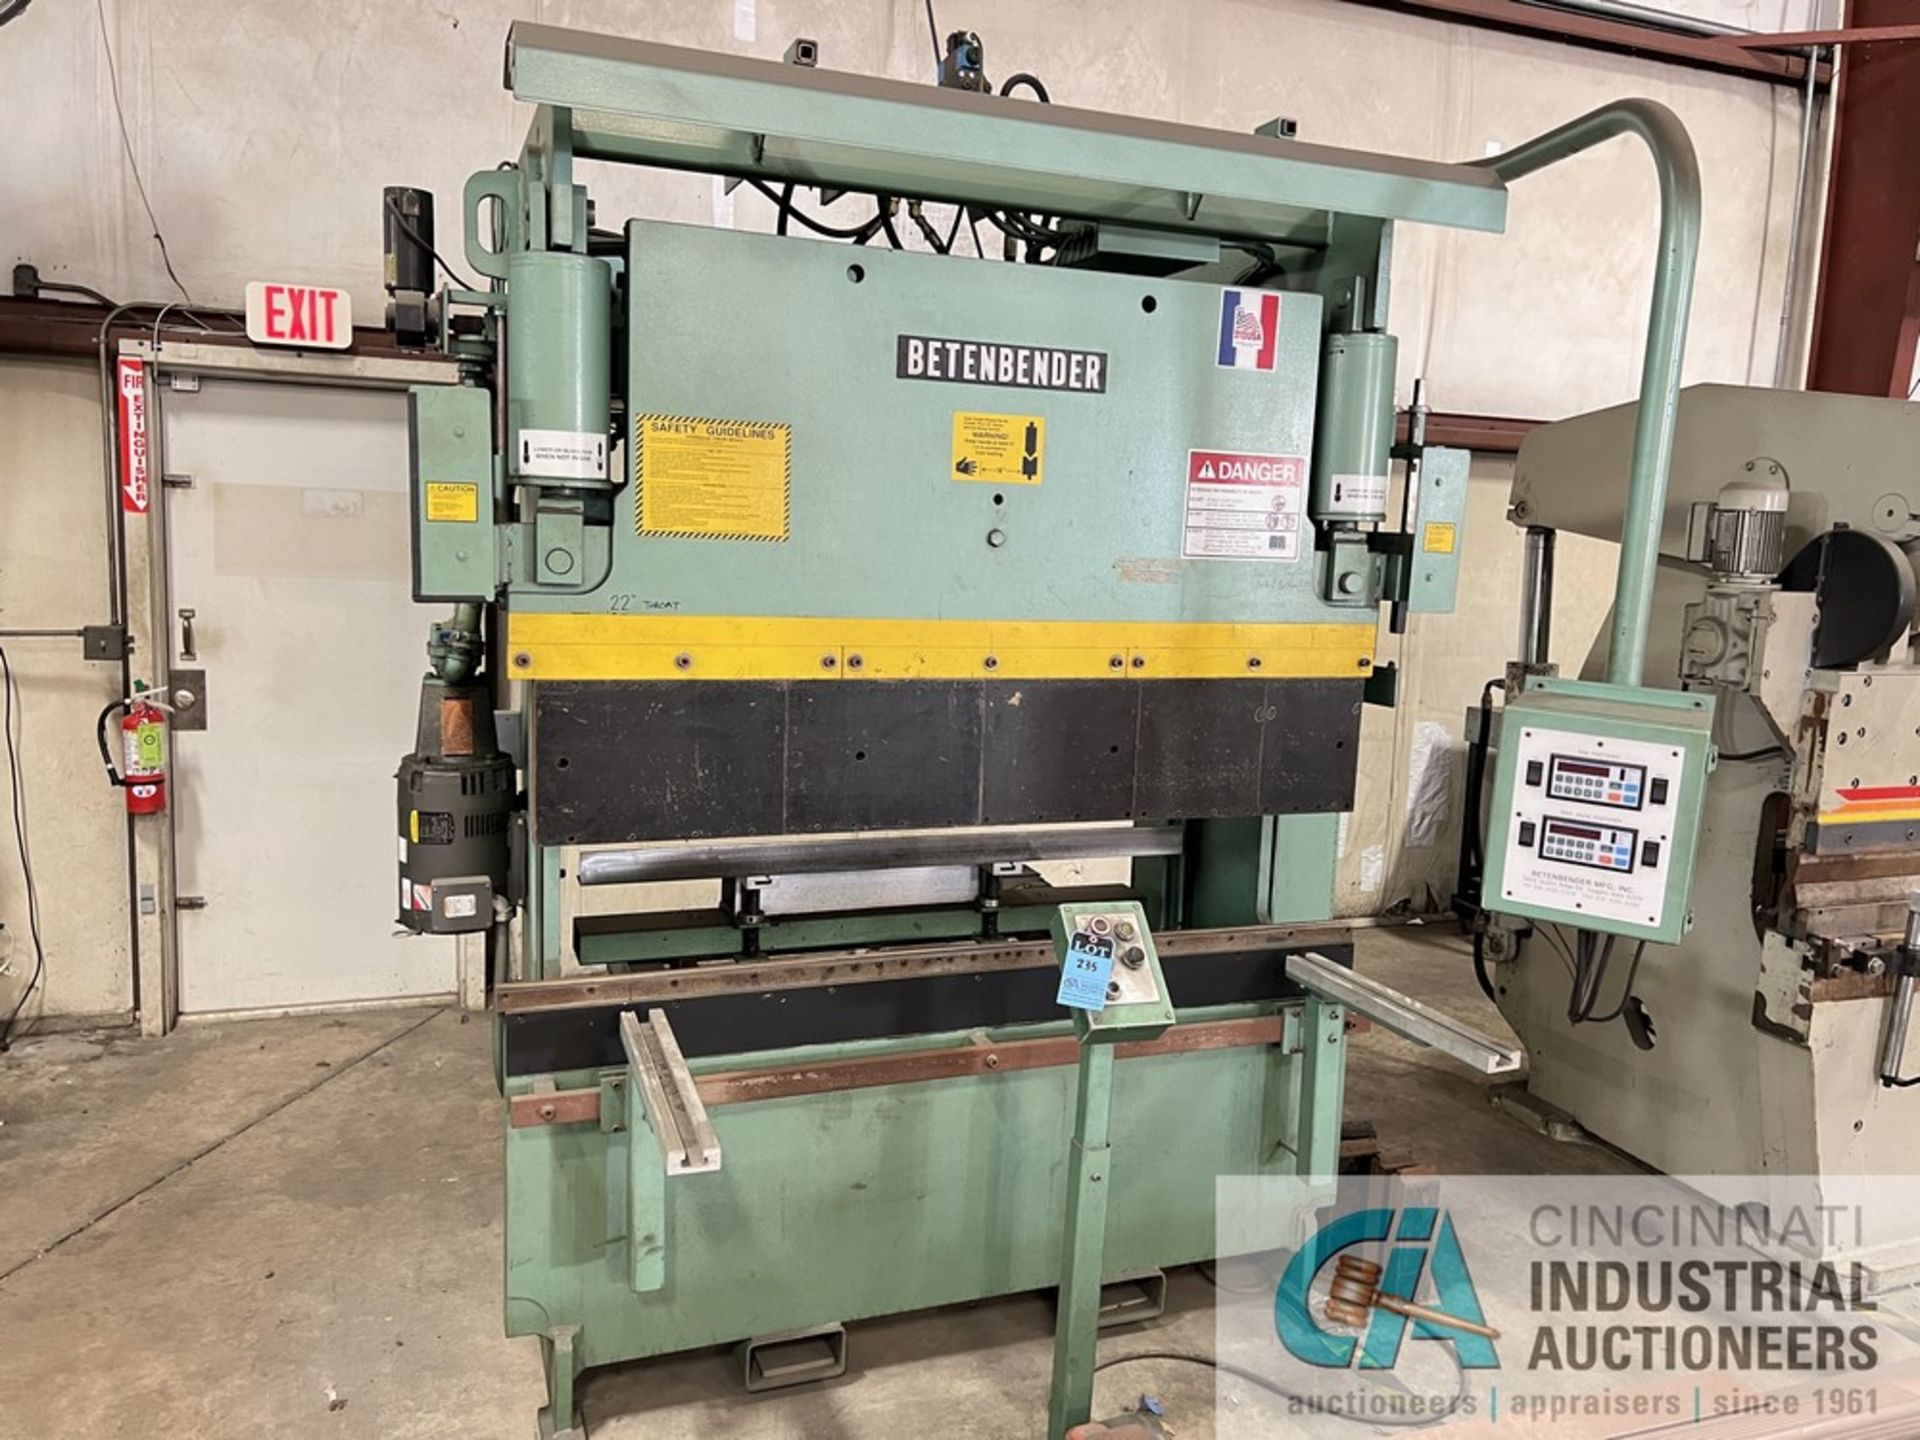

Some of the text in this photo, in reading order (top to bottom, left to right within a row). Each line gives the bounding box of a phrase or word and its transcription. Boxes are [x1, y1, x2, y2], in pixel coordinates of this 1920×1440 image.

[264, 285, 338, 342] EXIT
[907, 338, 1100, 389] BETENBENDER
[650, 422, 776, 440] SAFETY GUIDELINES
[133, 395, 147, 501] EXTINGUISHER
[1218, 462, 1297, 481] DANGER
[1531, 870, 1592, 885] BETENBENDER
[1075, 941, 1109, 957] LOT
[1076, 959, 1098, 972] 235
